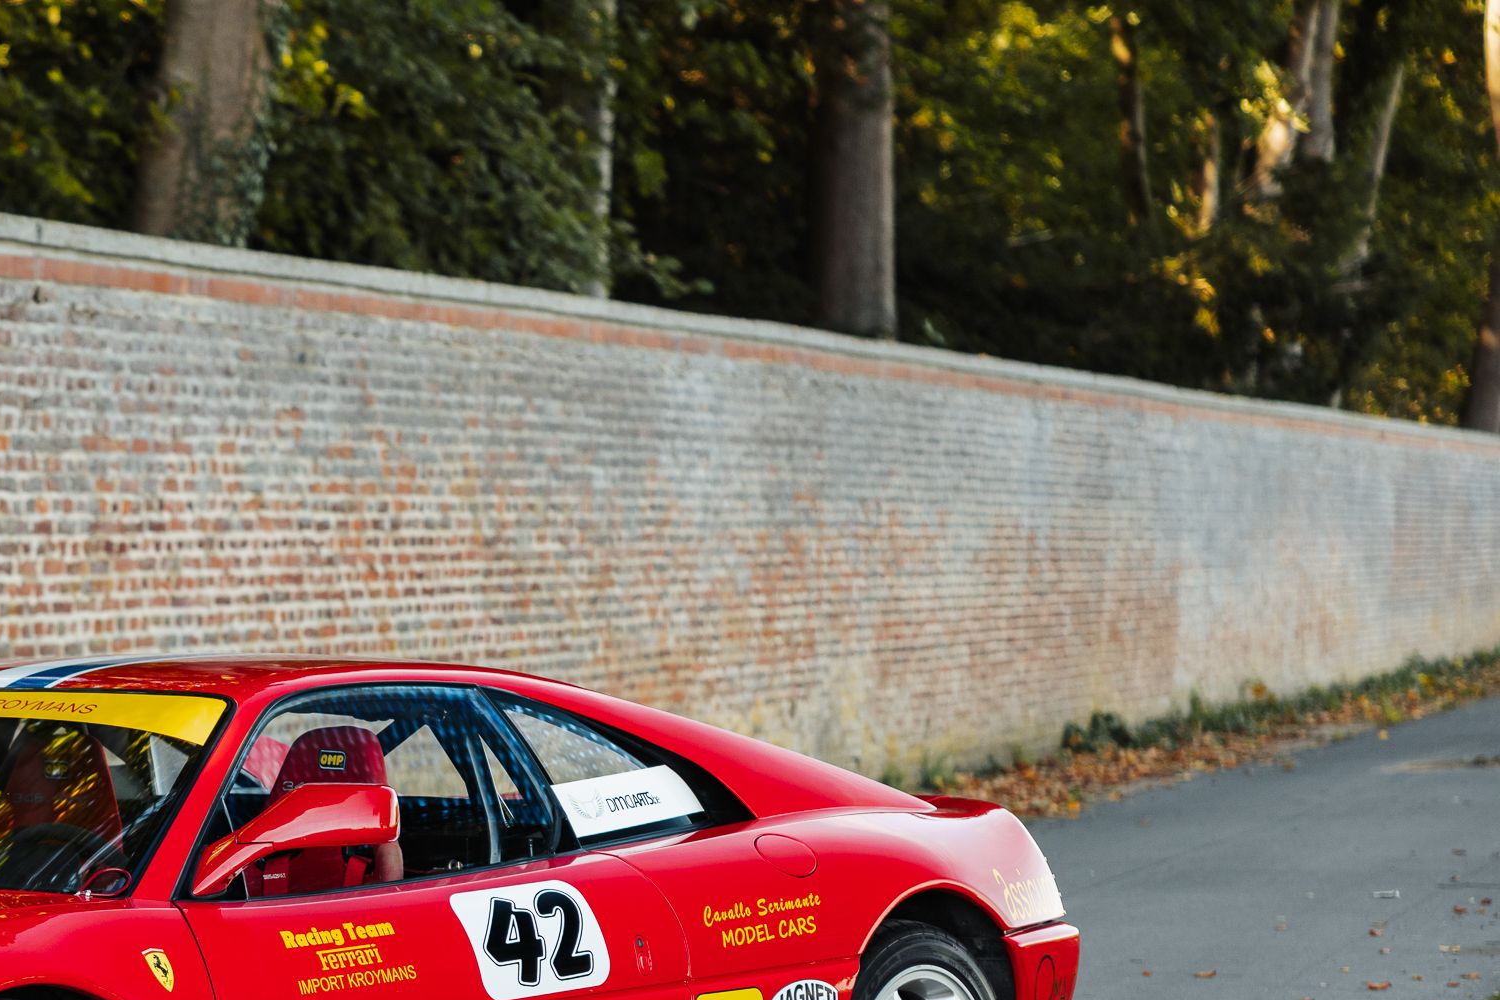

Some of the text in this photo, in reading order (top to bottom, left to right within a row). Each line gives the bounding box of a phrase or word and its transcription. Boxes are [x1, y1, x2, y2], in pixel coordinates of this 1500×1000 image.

[320, 754, 344, 767] OMP
[703, 902, 752, 928] Cavallo
[280, 921, 396, 949] Racing Team
[483, 888, 594, 987] 42
[722, 915, 817, 948] MODEL CARS
[316, 943, 384, 971] Ferrari
[298, 964, 418, 996] IMPORT KROYMANS
